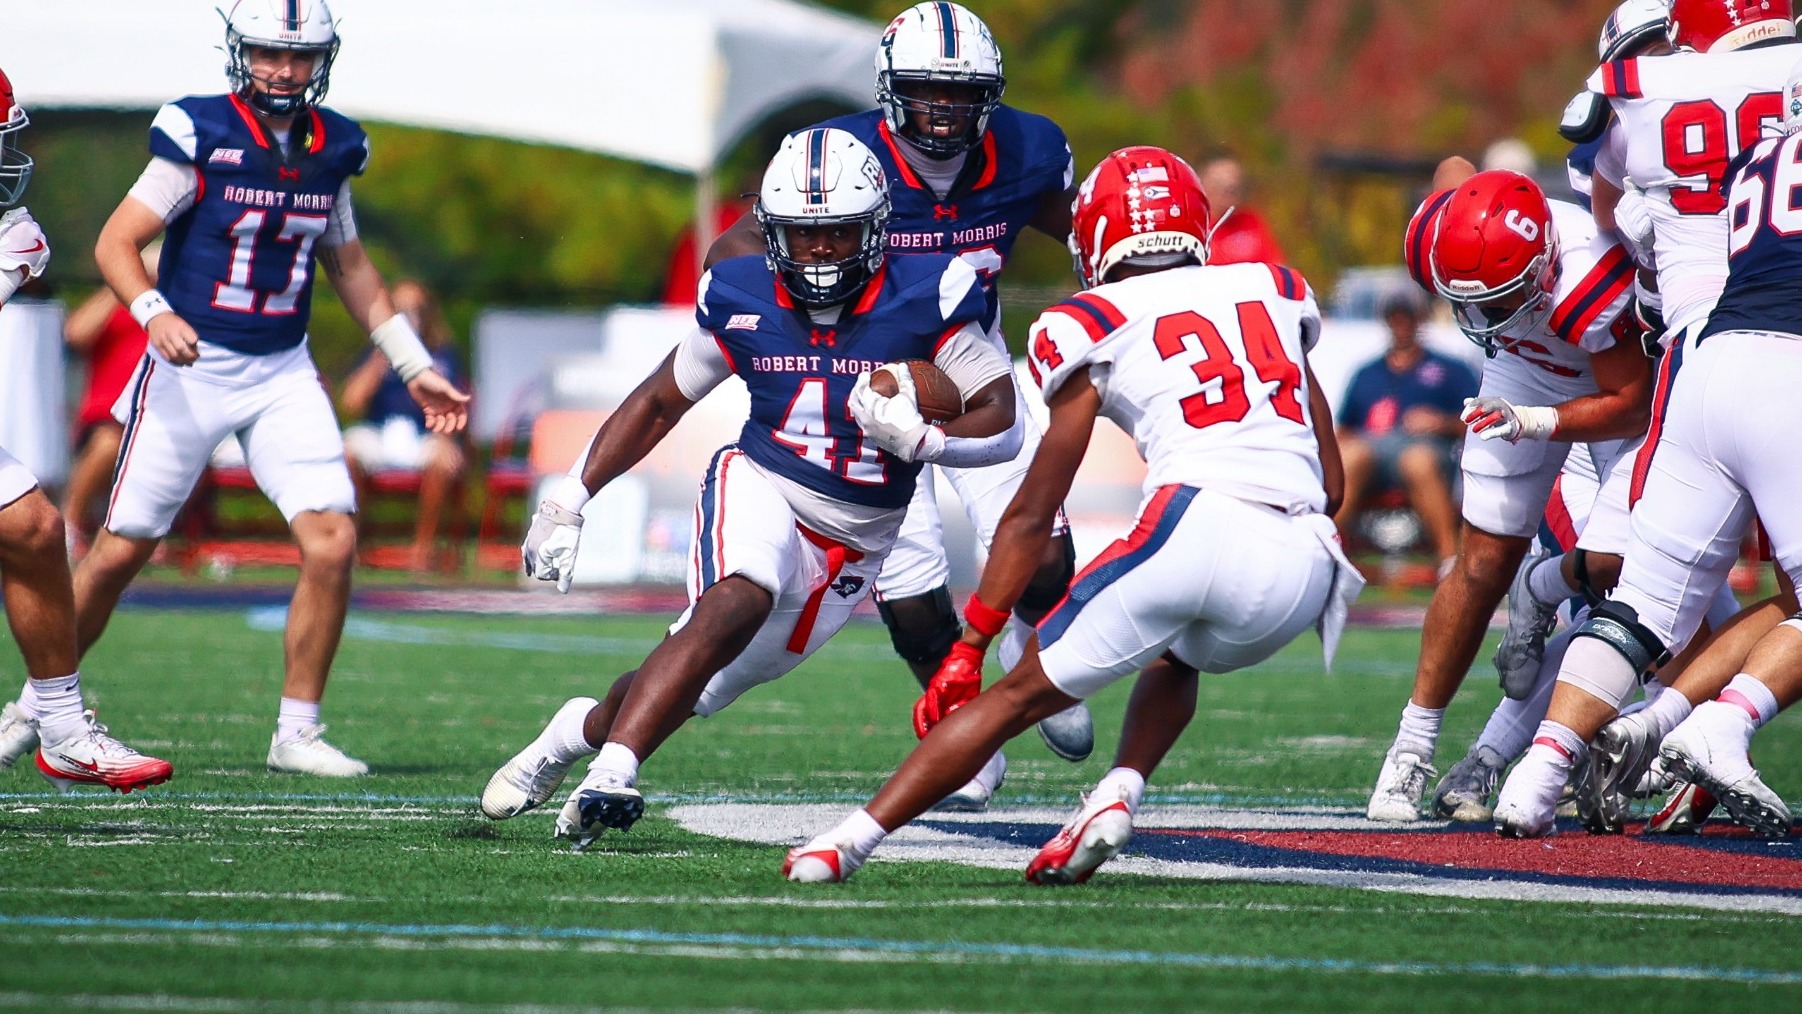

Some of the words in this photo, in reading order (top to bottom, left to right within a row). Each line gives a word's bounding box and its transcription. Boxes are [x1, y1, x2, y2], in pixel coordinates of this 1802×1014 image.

[224, 185, 286, 207] ROBERT
[885, 232, 944, 247] OBERT
[952, 222, 1007, 245] MORRIS
[1504, 208, 1539, 242] 6
[1138, 234, 1184, 249] schutt
[211, 208, 328, 315] 17
[728, 315, 759, 327] NEC
[752, 356, 821, 373] ROBERT
[832, 358, 885, 375] MORR
[1153, 300, 1307, 430] 34
[771, 377, 889, 486] 41
